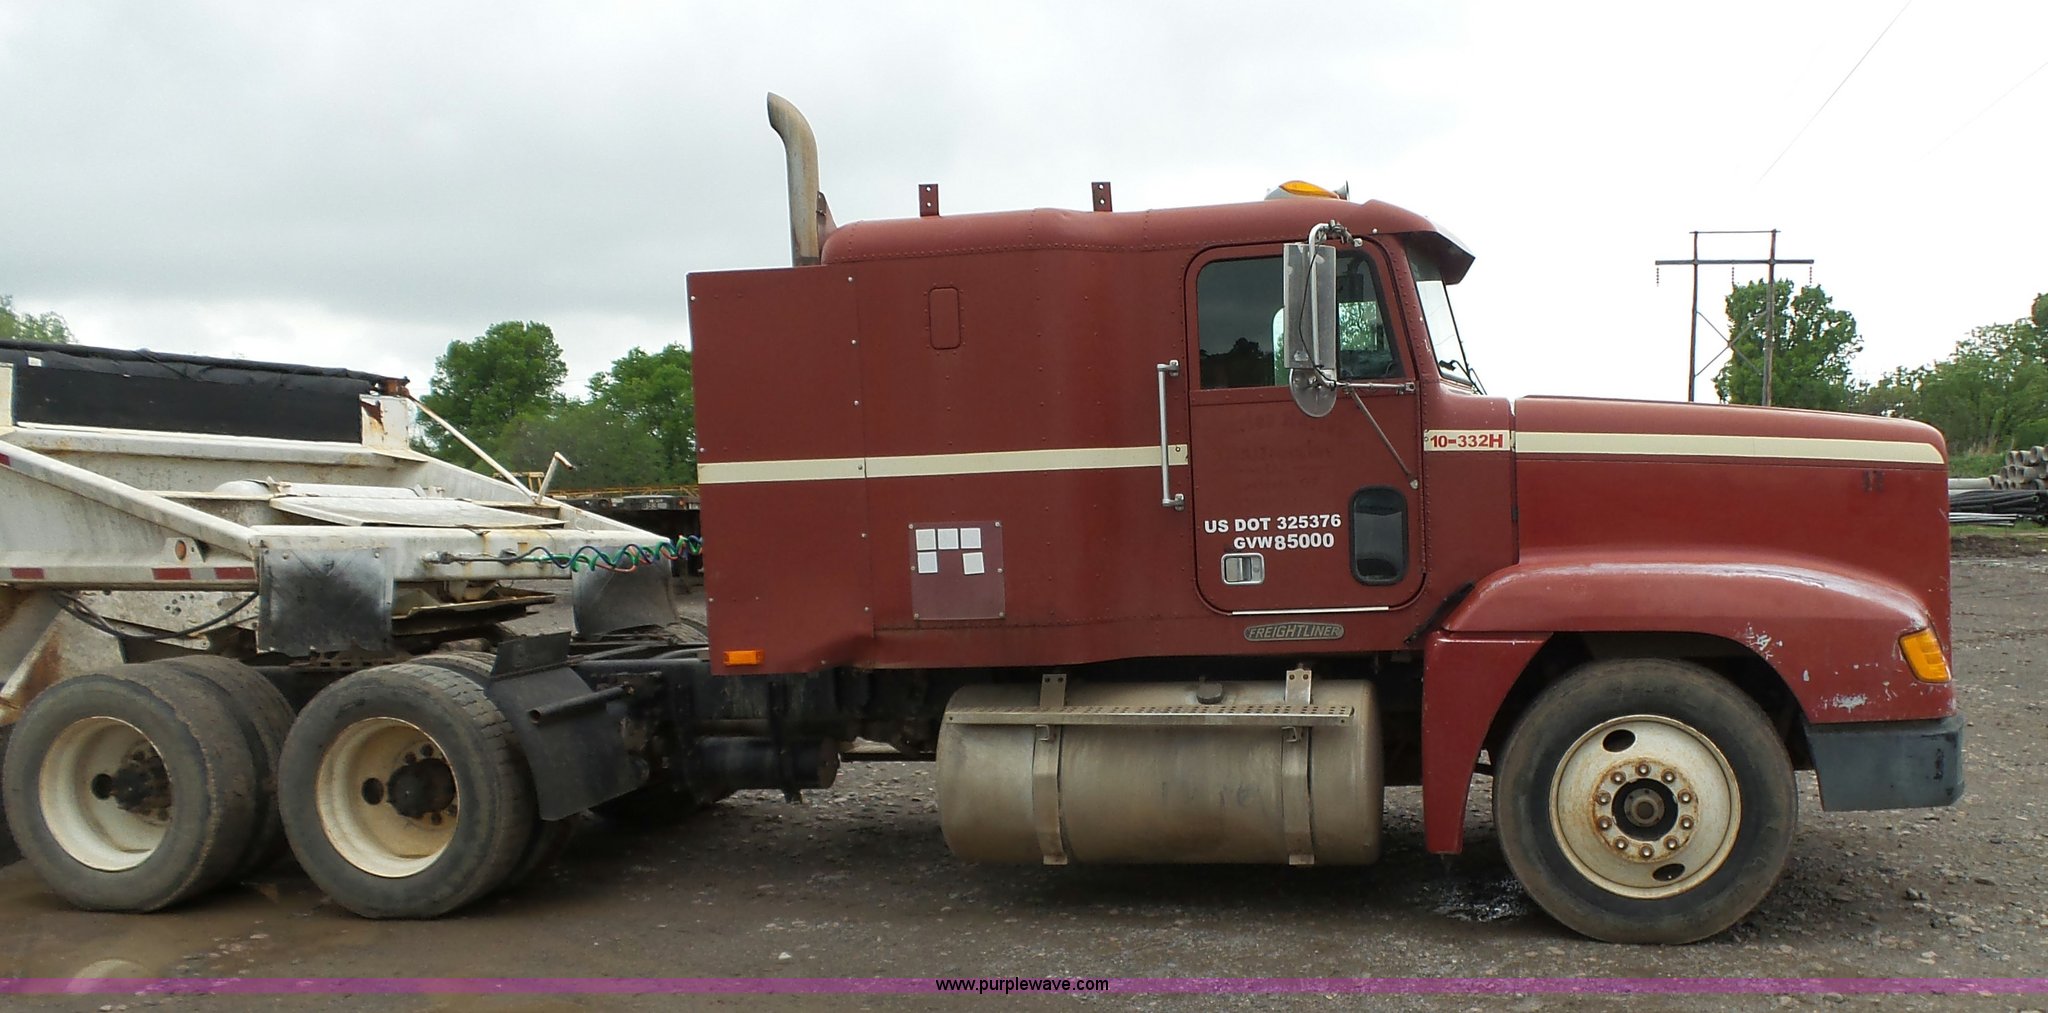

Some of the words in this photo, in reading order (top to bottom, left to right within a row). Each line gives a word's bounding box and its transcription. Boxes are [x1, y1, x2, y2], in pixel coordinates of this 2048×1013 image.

[1430, 433, 1504, 449] 10-332H
[1204, 520, 1229, 533] US
[1234, 517, 1271, 532] DOT
[1277, 514, 1342, 530] 325376
[1248, 623, 1341, 639] FREIGHTLINER
